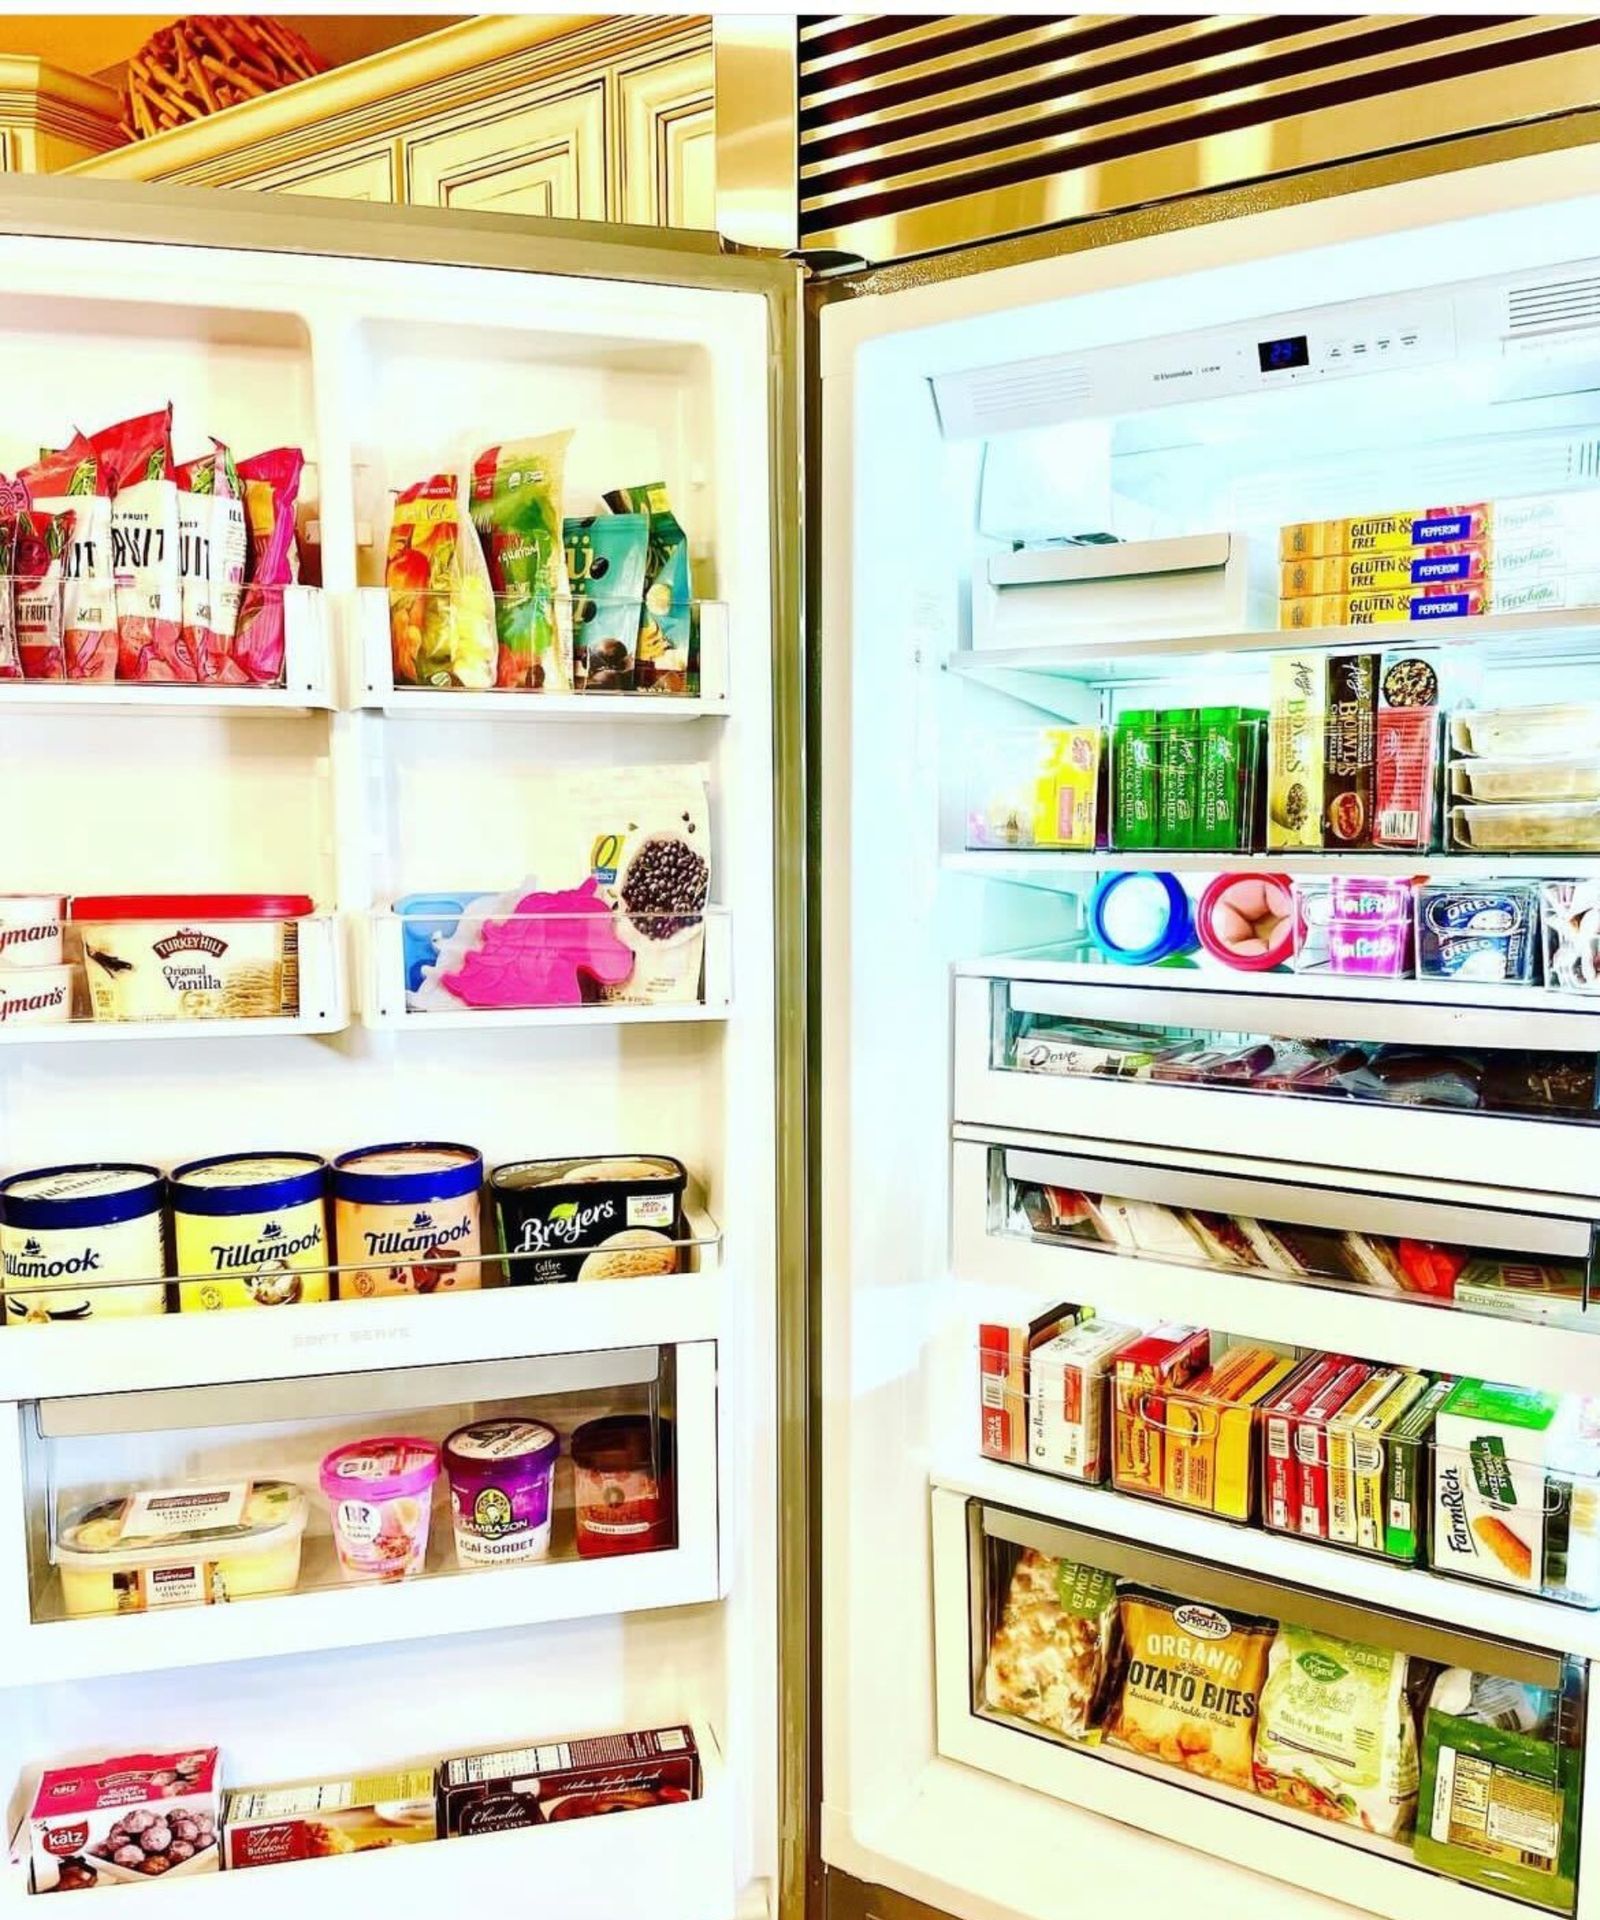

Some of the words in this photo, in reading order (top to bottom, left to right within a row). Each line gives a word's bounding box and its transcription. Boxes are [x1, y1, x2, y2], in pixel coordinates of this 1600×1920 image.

[1351, 521, 1396, 537] GLUTEN
[1420, 524, 1461, 538] PEPPERONI
[1352, 537, 1377, 549] FREE
[1350, 559, 1395, 575] GLUTEN
[1419, 563, 1459, 576] PEPPERONI
[1351, 574, 1375, 586] FREE
[25, 605, 53, 621] FRUIT
[1349, 597, 1395, 613] GLUTEN
[1418, 602, 1458, 615] PEPPERONI
[1350, 612, 1374, 625] FREE
[1341, 662, 1371, 701] Amy's
[1337, 700, 1358, 776] BOWLS
[1216, 762, 1225, 797] VEGAN
[1446, 897, 1498, 919] OREO
[0, 919, 59, 954] yman's
[155, 937, 200, 954] TURKEY
[200, 937, 223, 953] HILL
[1441, 938, 1491, 961] OREO
[162, 964, 206, 977] Original
[166, 974, 222, 990] Vanilla
[0, 986, 66, 1021] yman's
[1025, 1044, 1082, 1067] Dove
[364, 1216, 472, 1257] Tillamook
[514, 1199, 615, 1253] Breyers
[211, 1223, 322, 1271] Tillamook
[484, 1538, 534, 1554] SORBET
[1063, 1563, 1078, 1585] TIN
[1072, 1566, 1091, 1609] LOWER
[1176, 1610, 1228, 1633] SPROUTS
[1147, 1634, 1243, 1679] ORGANIC
[1129, 1660, 1196, 1702] OTATO
[1201, 1682, 1256, 1718] BITES
[471, 1803, 526, 1824] Chocolate
